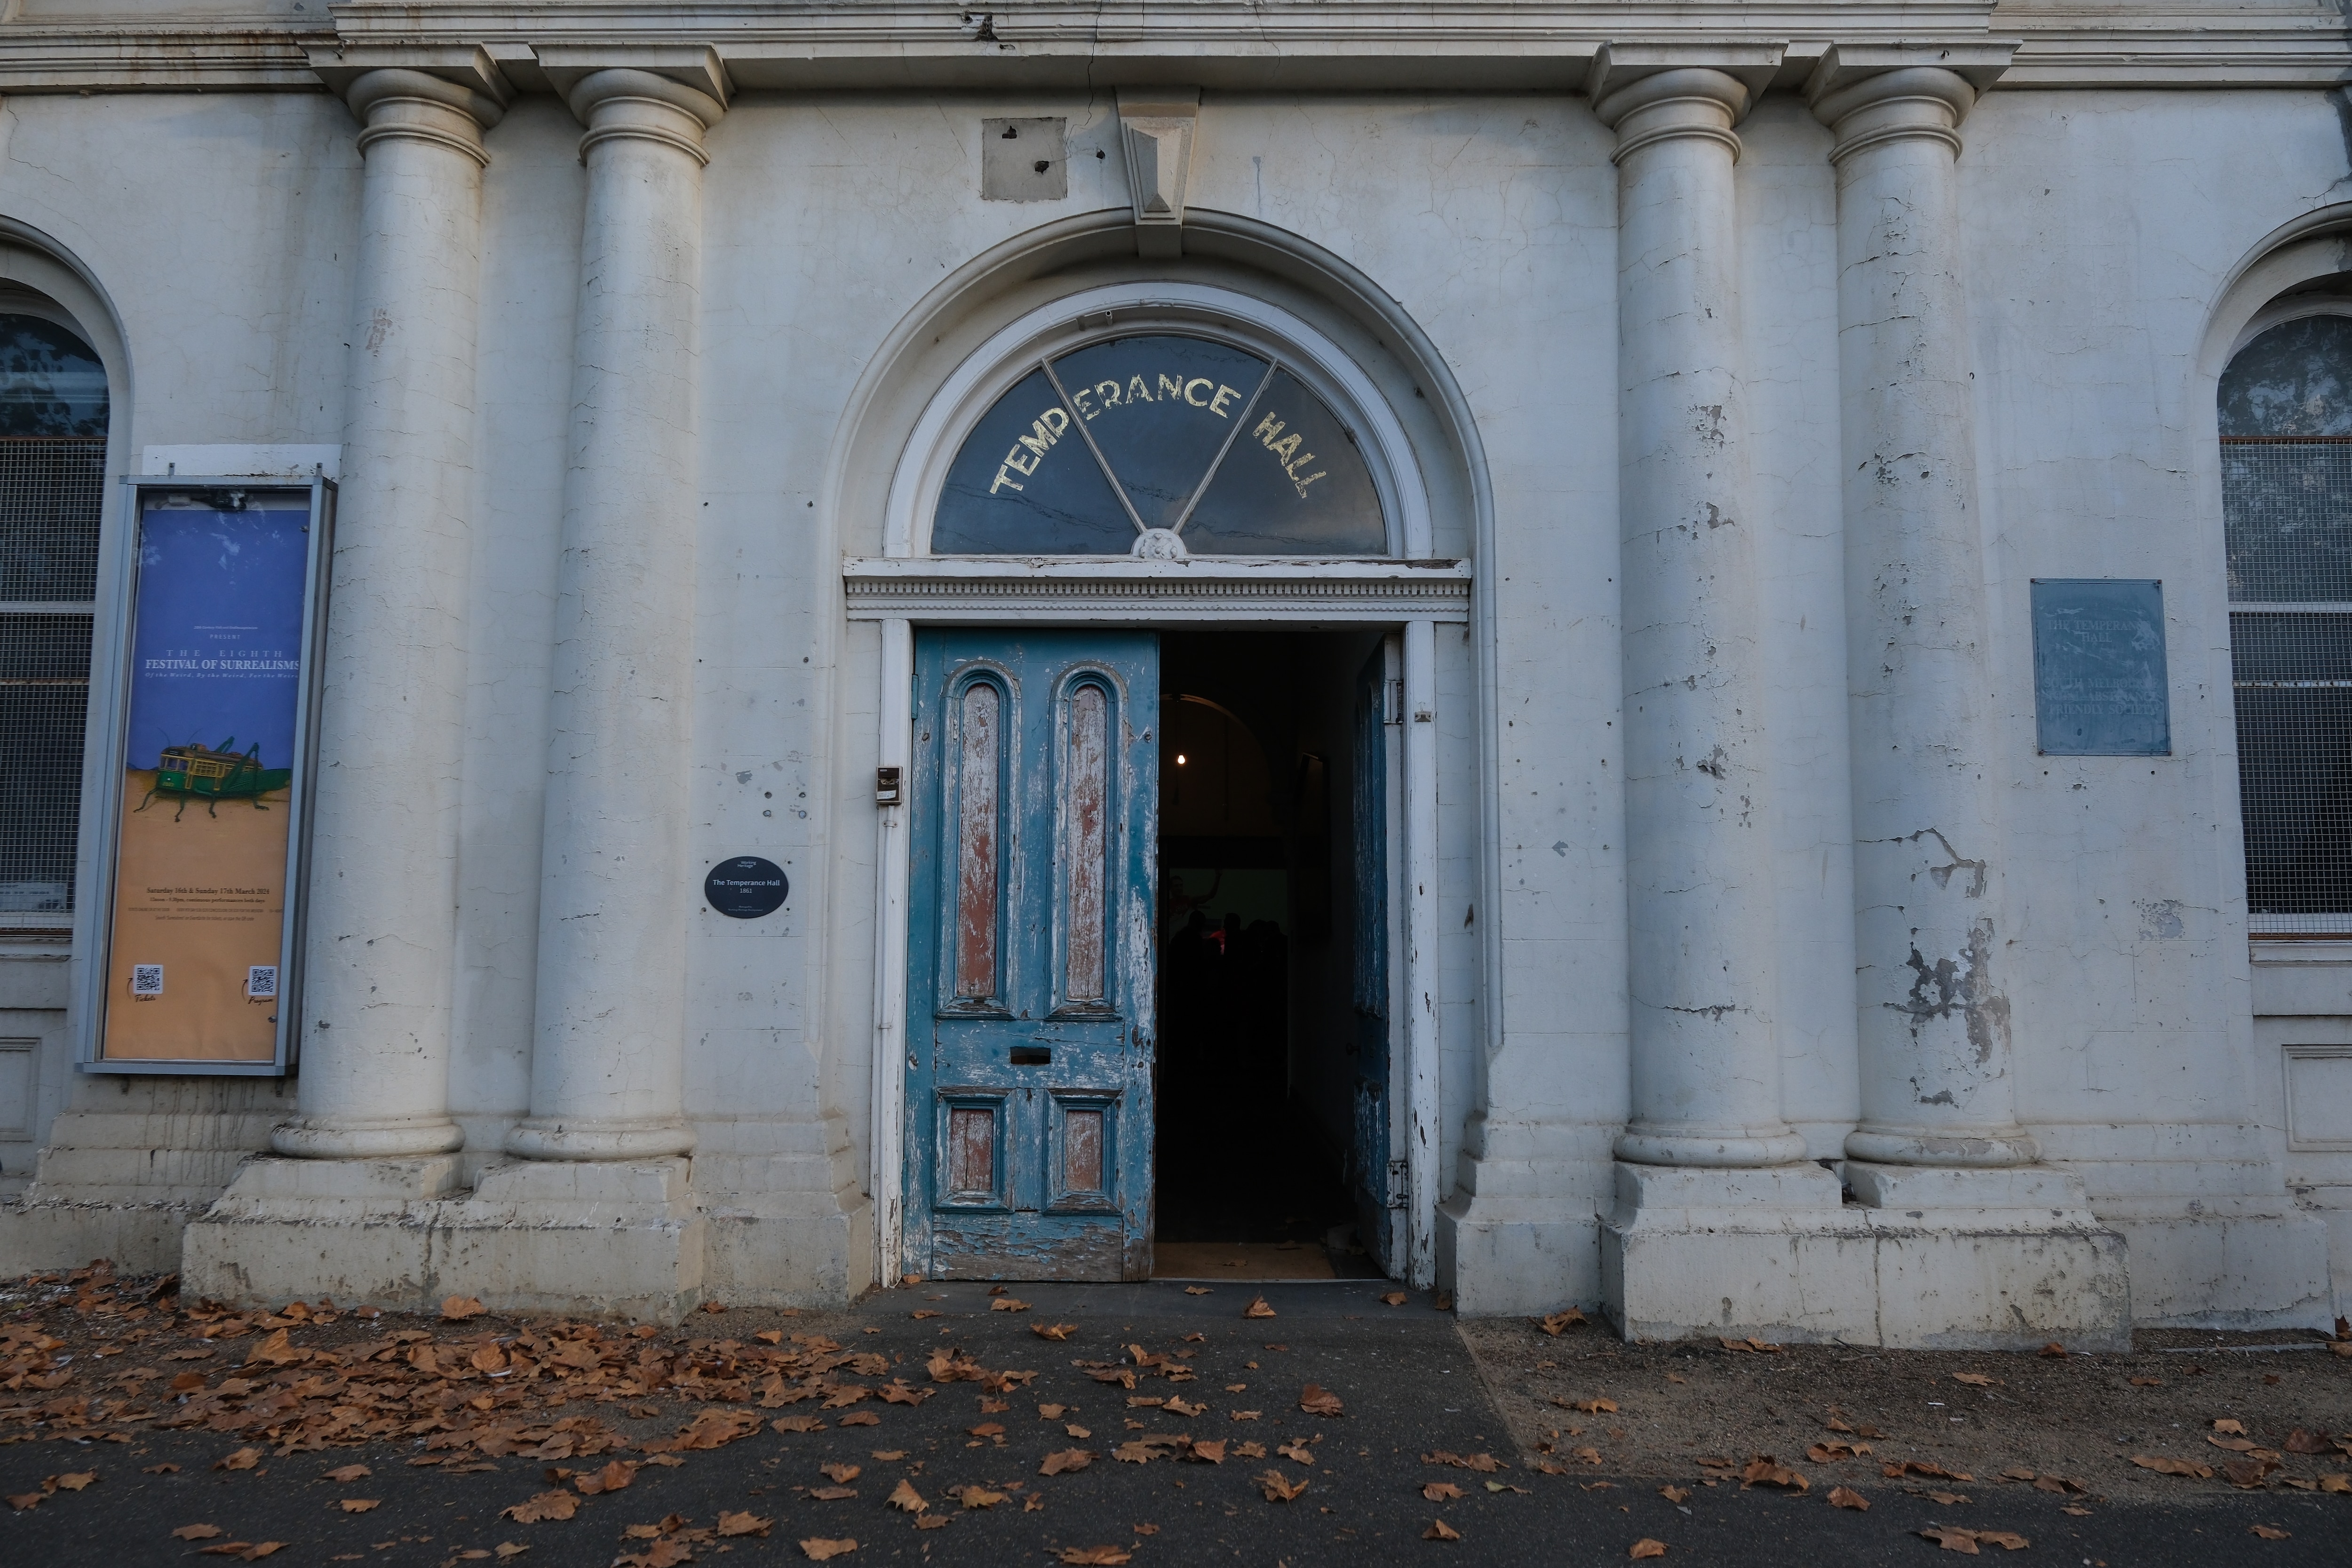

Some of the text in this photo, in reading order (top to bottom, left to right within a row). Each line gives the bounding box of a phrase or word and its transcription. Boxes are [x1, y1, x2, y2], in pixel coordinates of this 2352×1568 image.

[1252, 411, 1327, 499] HALL
[2048, 620, 2151, 630] THE TEMPERAN
[2082, 632, 2113, 642] HALL
[145, 659, 299, 670] FESTIVAL OF SURREALISMS
[2088, 678, 2159, 688] MELBOUE
[2049, 704, 2103, 715] FRIENDLY
[135, 994, 274, 1006] Tickets Program
